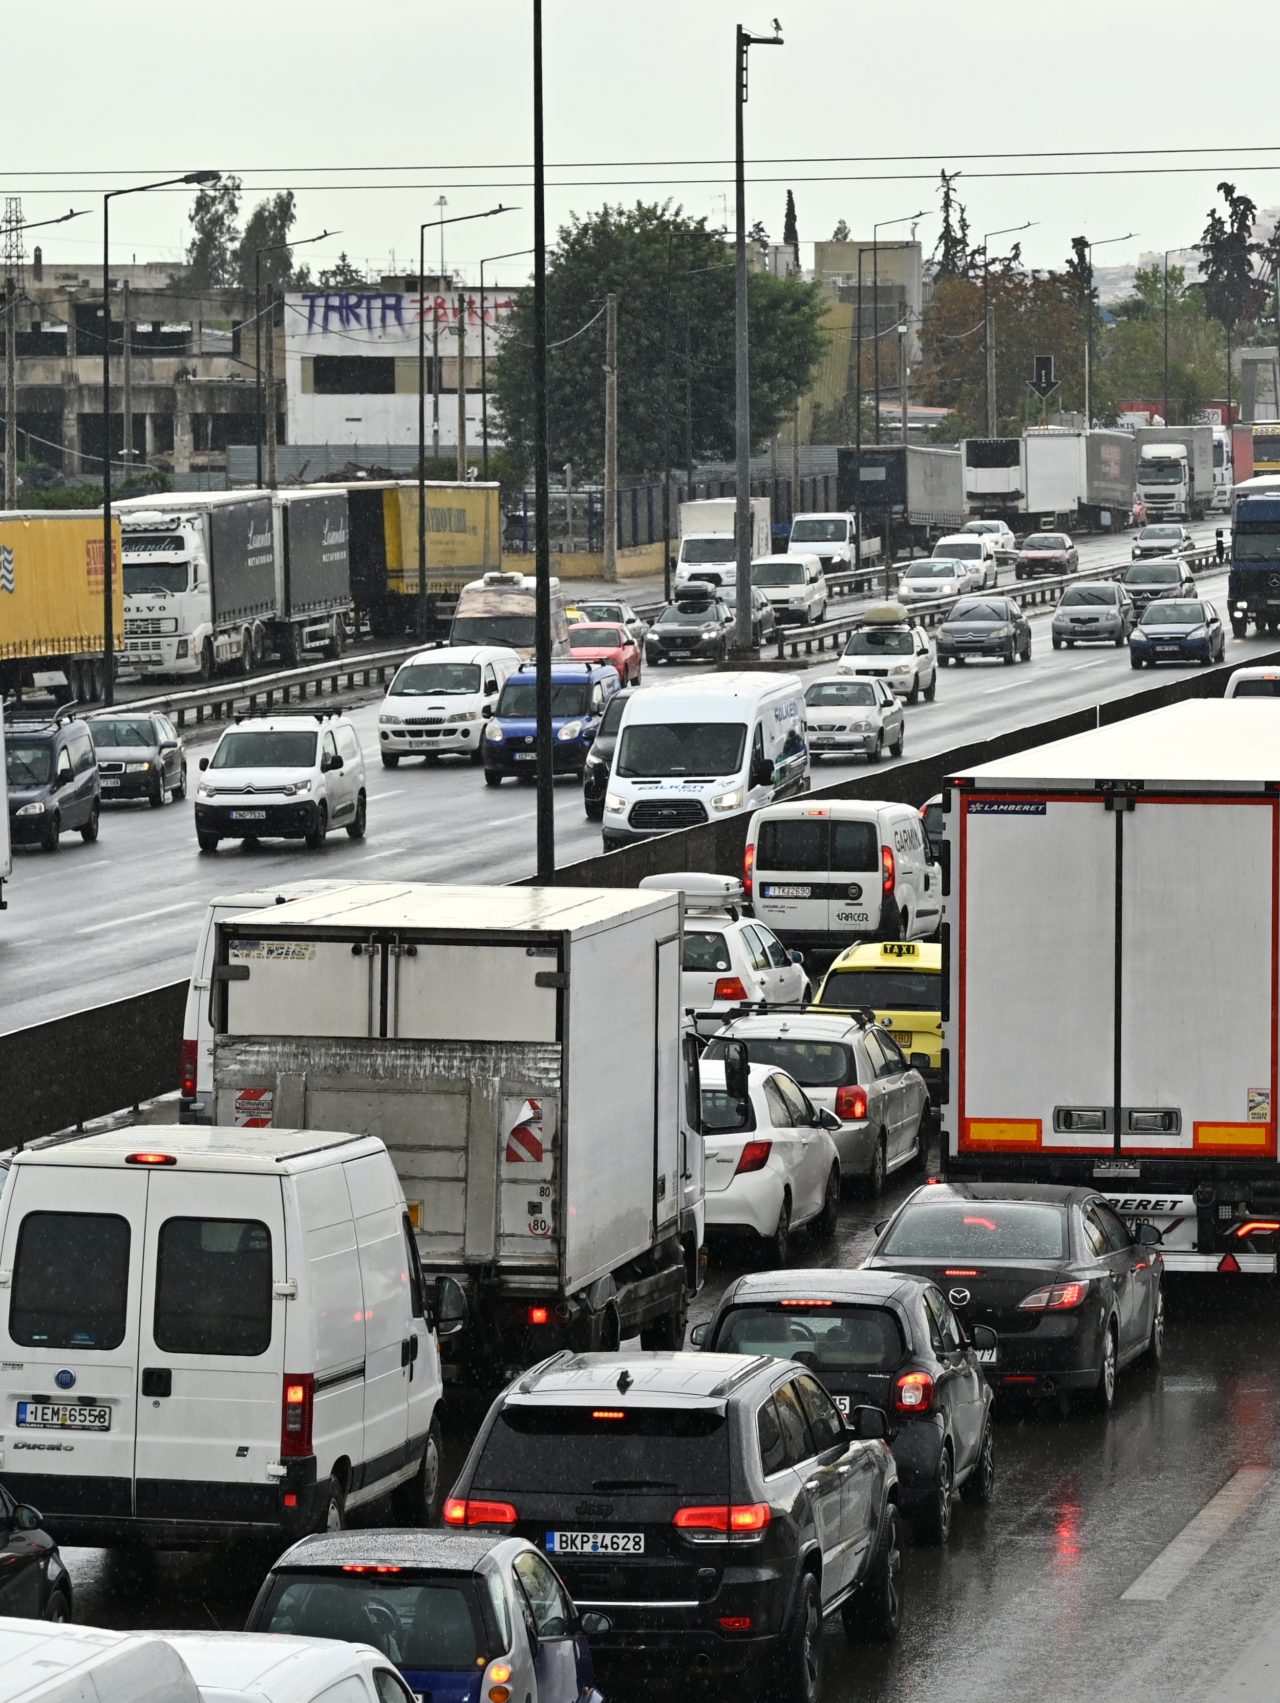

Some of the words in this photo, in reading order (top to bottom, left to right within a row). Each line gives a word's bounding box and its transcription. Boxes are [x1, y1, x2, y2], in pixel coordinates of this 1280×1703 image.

[302, 293, 404, 333] TARTA
[124, 605, 167, 613] OLVO
[984, 803, 1044, 813] LAMBERET
[894, 828, 922, 853] GARMIN
[886, 944, 914, 954] TAXI
[539, 1186, 551, 1198] 80
[1107, 1199, 1184, 1211] BERET
[532, 1219, 547, 1231] 80
[14, 1441, 75, 1453] Ducato
[575, 1502, 614, 1517] Jeep
